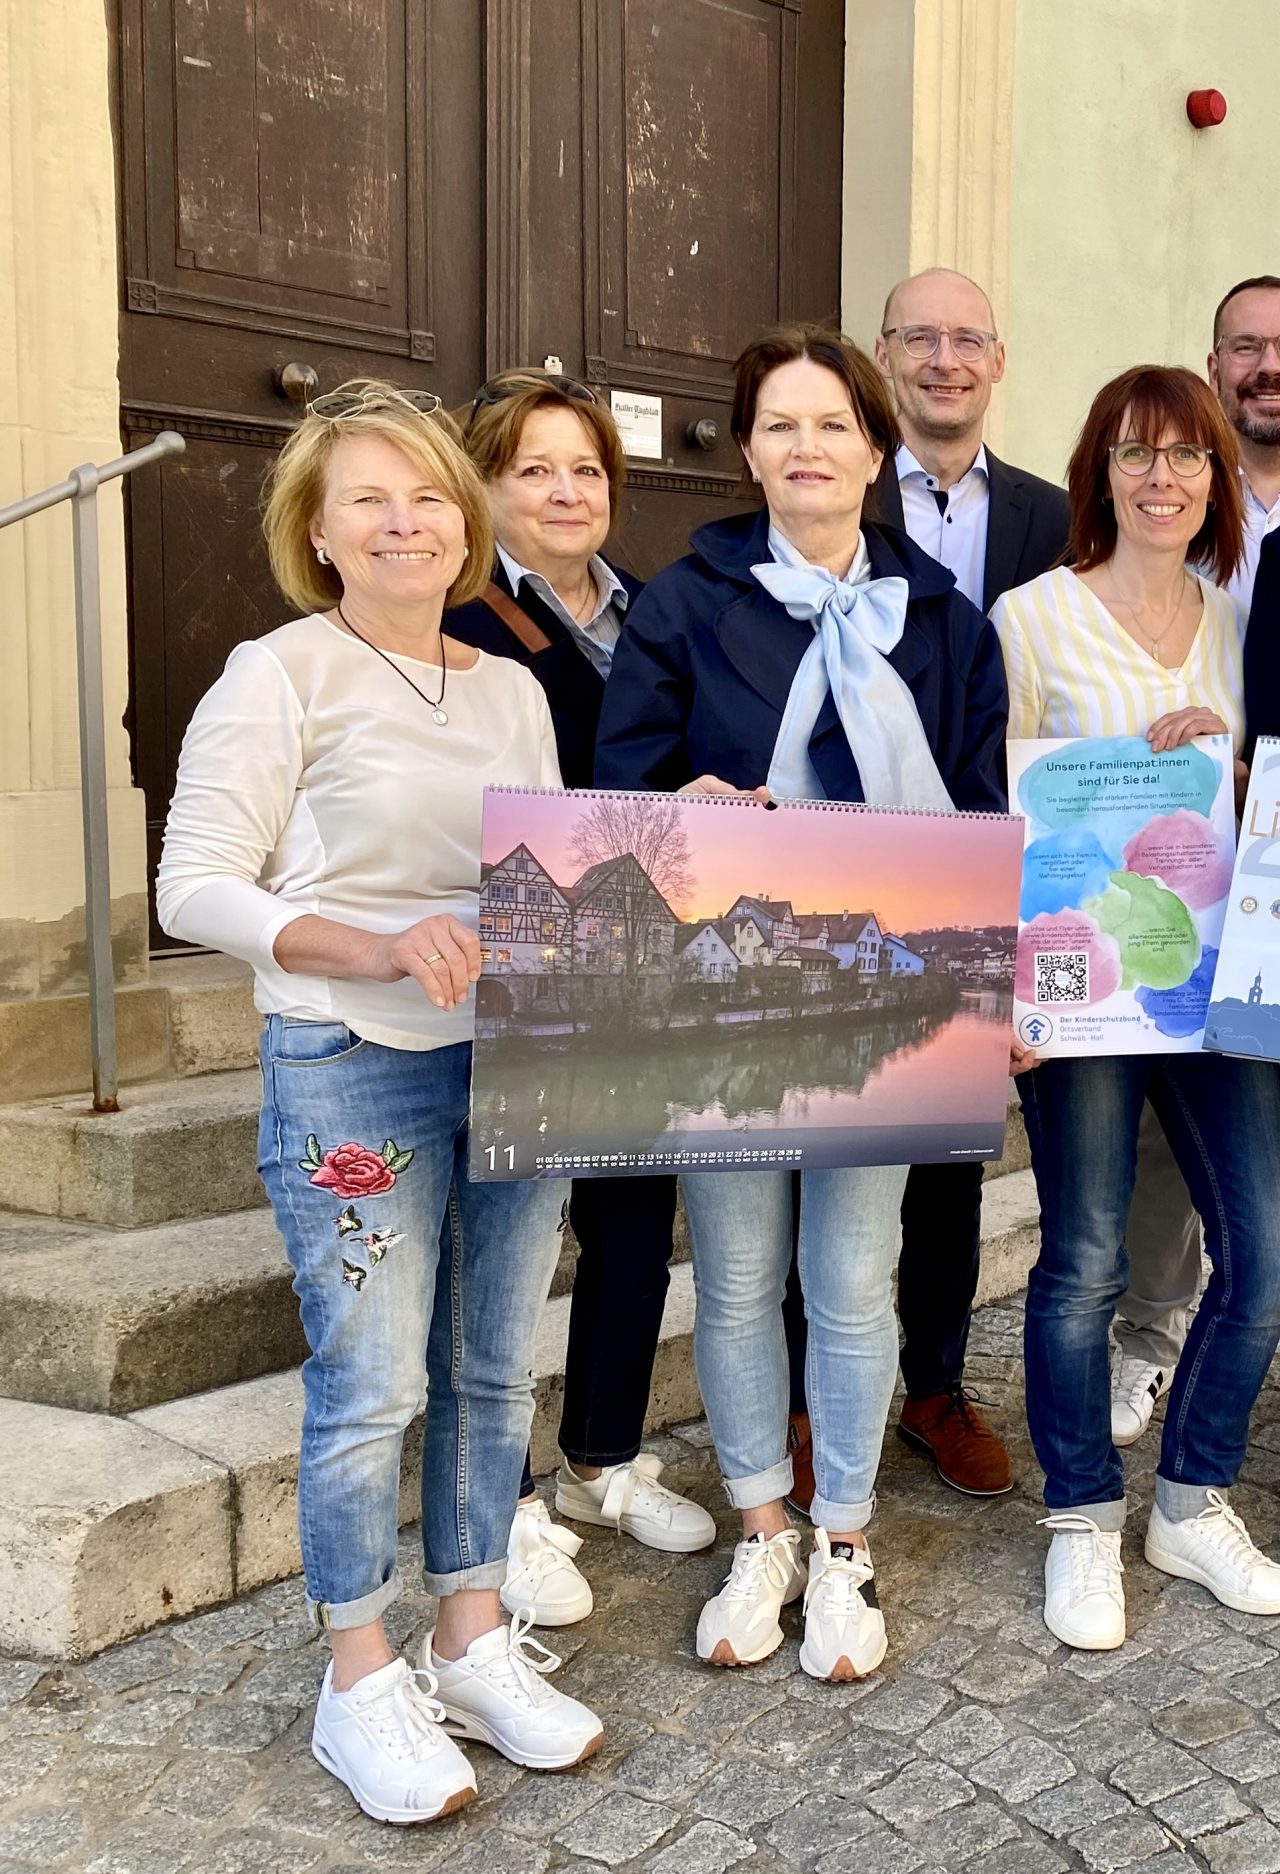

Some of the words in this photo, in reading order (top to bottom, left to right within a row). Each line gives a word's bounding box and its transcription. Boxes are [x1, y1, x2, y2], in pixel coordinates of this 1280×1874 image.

[1046, 762, 1086, 772] Unsere
[1077, 777, 1101, 787] sind
[1104, 776, 1120, 785] für
[1123, 775, 1140, 785] Sie
[1143, 774, 1160, 784] da!
[484, 1144, 515, 1170] 11
